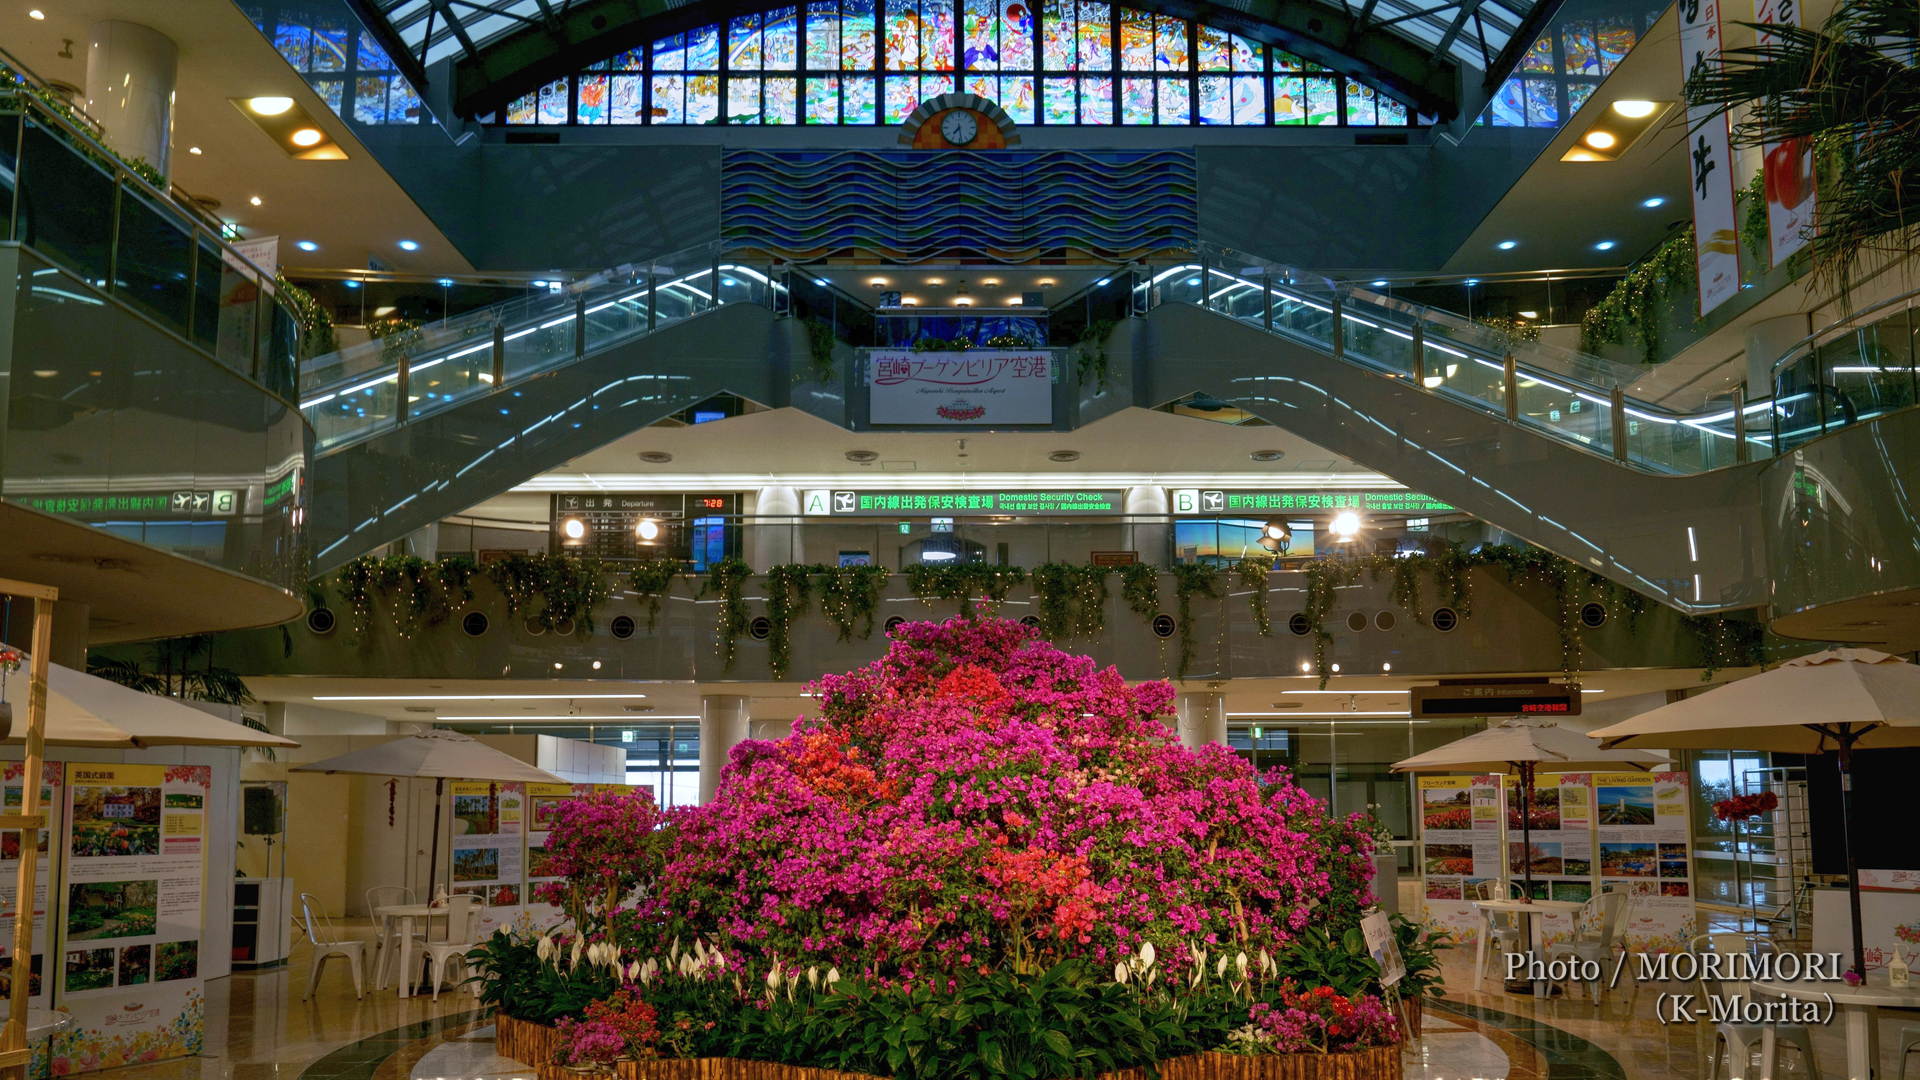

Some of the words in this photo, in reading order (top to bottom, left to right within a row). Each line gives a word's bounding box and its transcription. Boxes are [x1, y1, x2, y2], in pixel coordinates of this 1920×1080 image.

[875, 355, 1047, 382] 宮崎ブーゲンビリア空港
[621, 499, 655, 509] Departure
[703, 498, 723, 508] 7:28
[808, 494, 824, 512] A
[860, 495, 994, 509] 国内線出発保安検査場
[999, 492, 1038, 501] Domestic
[1040, 492, 1074, 502] Security
[1076, 492, 1103, 501] Check
[1179, 494, 1193, 511] B
[1229, 495, 1360, 509] 国内線出発保安検査場
[1365, 493, 1403, 501] Domestic
